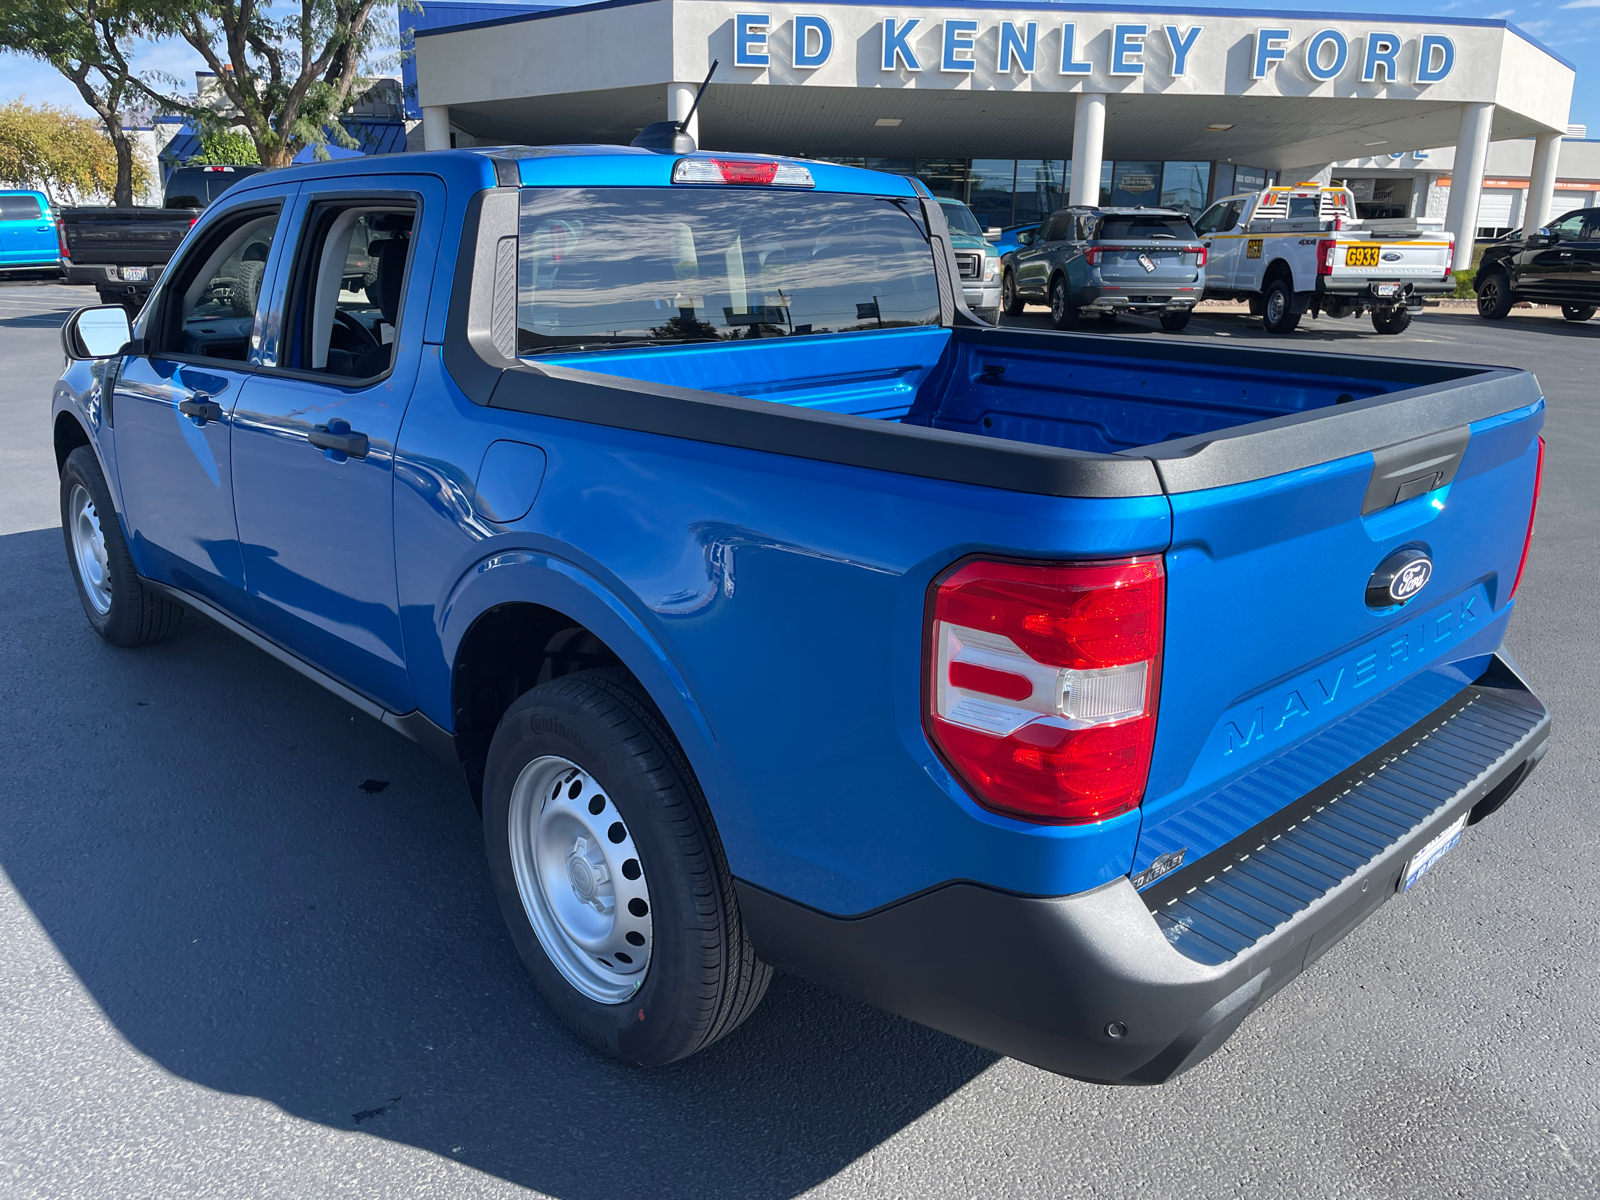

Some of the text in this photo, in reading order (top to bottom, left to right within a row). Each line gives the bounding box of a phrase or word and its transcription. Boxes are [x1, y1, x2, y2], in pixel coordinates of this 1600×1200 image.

[733, 12, 1457, 84] ED KENLEY FORD
[1346, 248, 1379, 266] G933
[1398, 564, 1427, 596] Ford
[1223, 595, 1476, 756] MAVERICK
[530, 713, 599, 760] Continental
[1132, 852, 1186, 888] ED KENLEY
